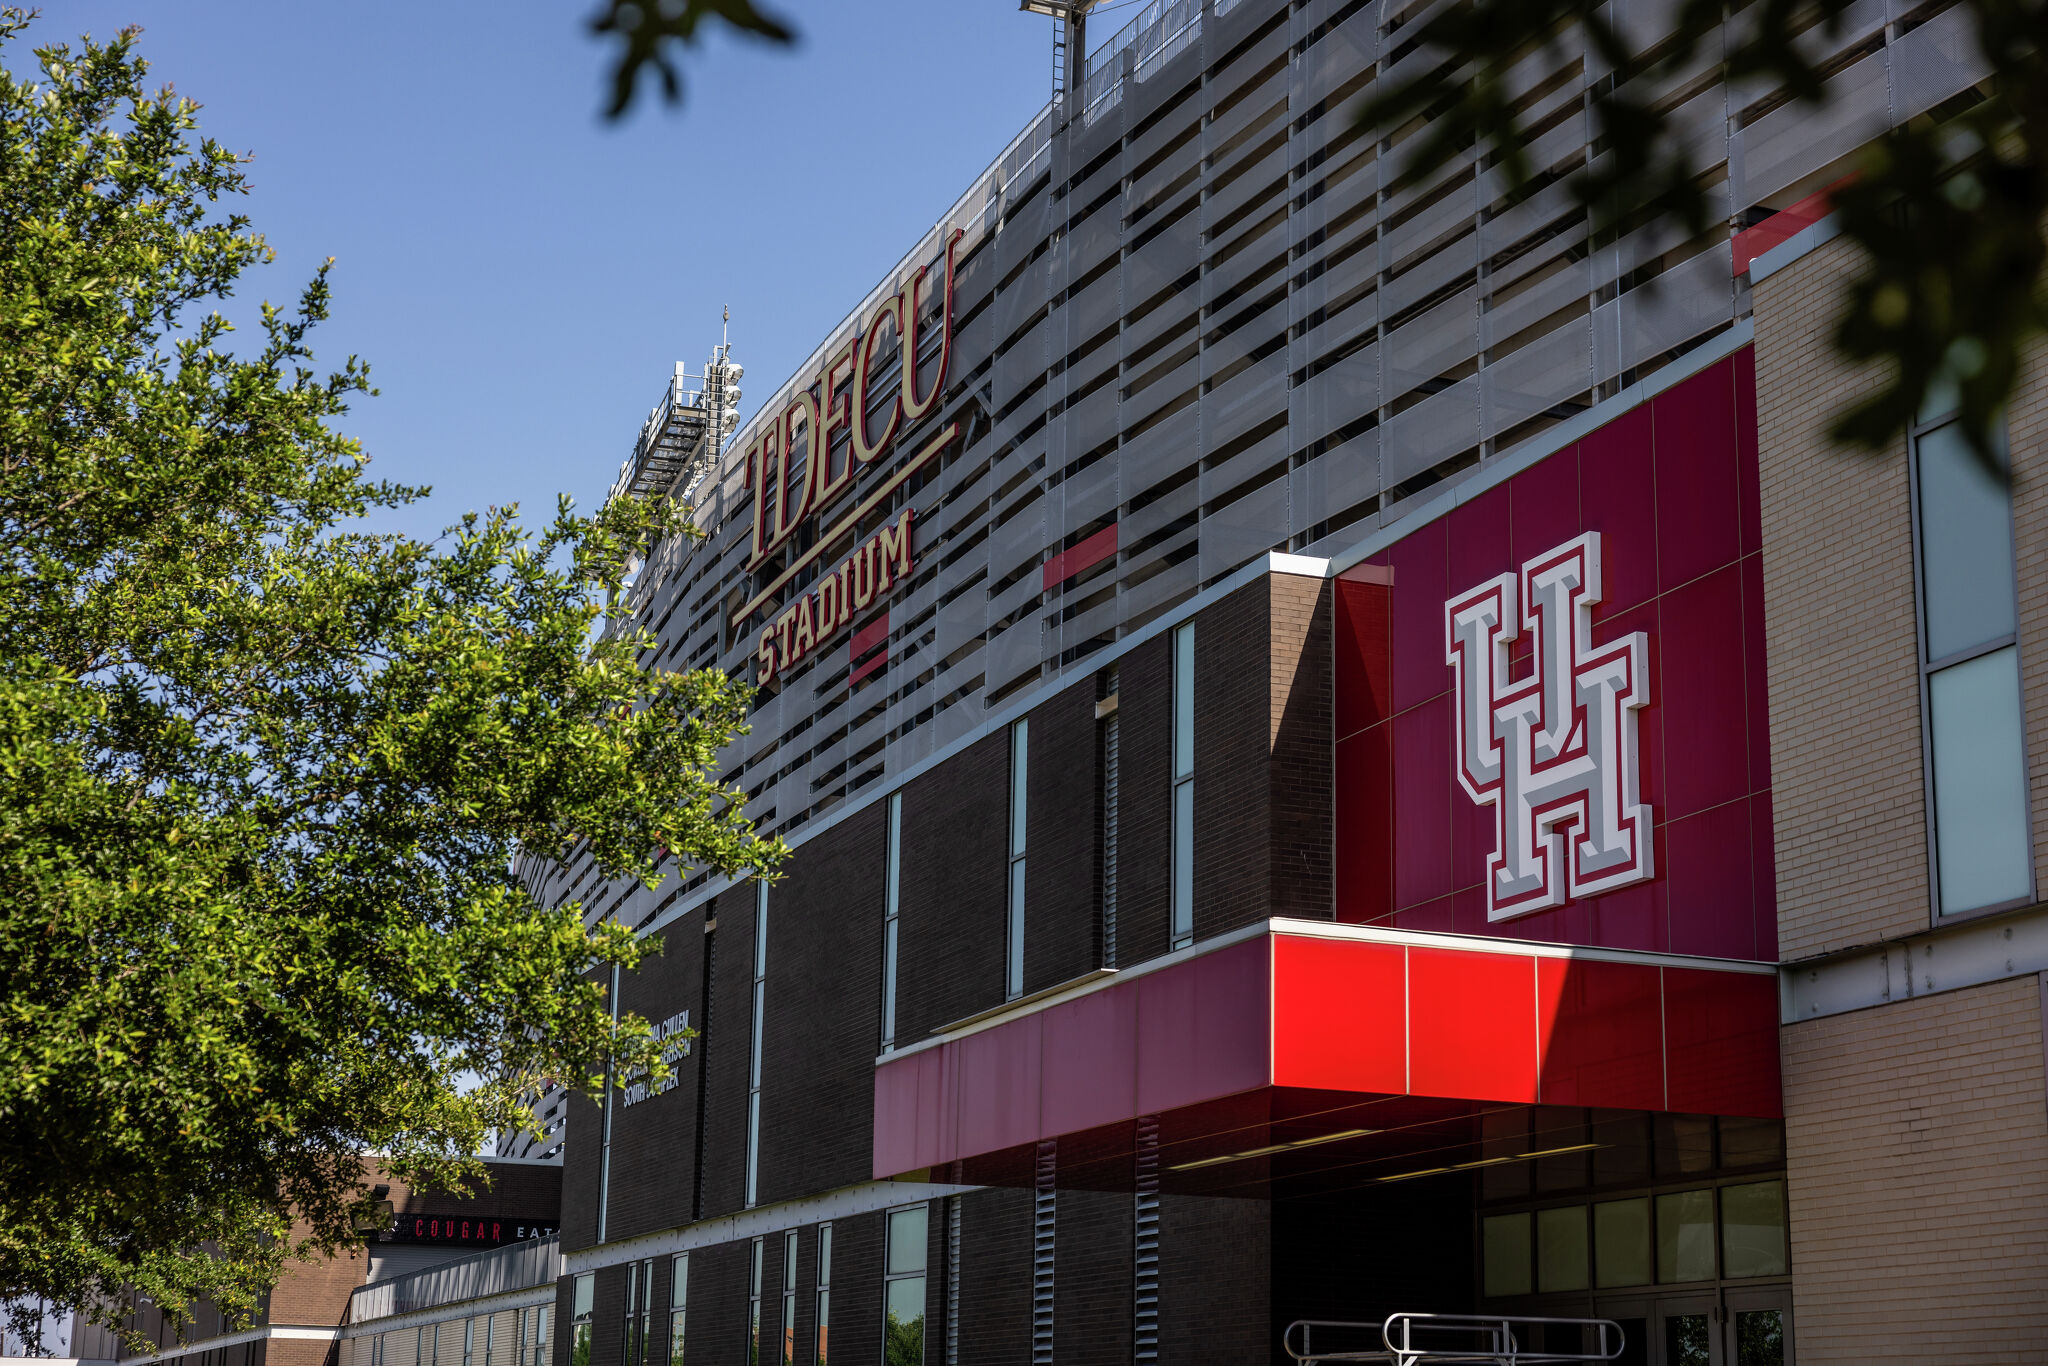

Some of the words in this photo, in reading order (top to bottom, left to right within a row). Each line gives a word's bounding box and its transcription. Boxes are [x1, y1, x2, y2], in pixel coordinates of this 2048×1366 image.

[743, 228, 965, 573] TDECU
[757, 508, 914, 687] STADIUM
[1445, 531, 1654, 922] UH
[624, 1080, 646, 1108] SOUTH
[415, 1219, 501, 1241] COUGAR
[517, 1226, 561, 1238] EAT
